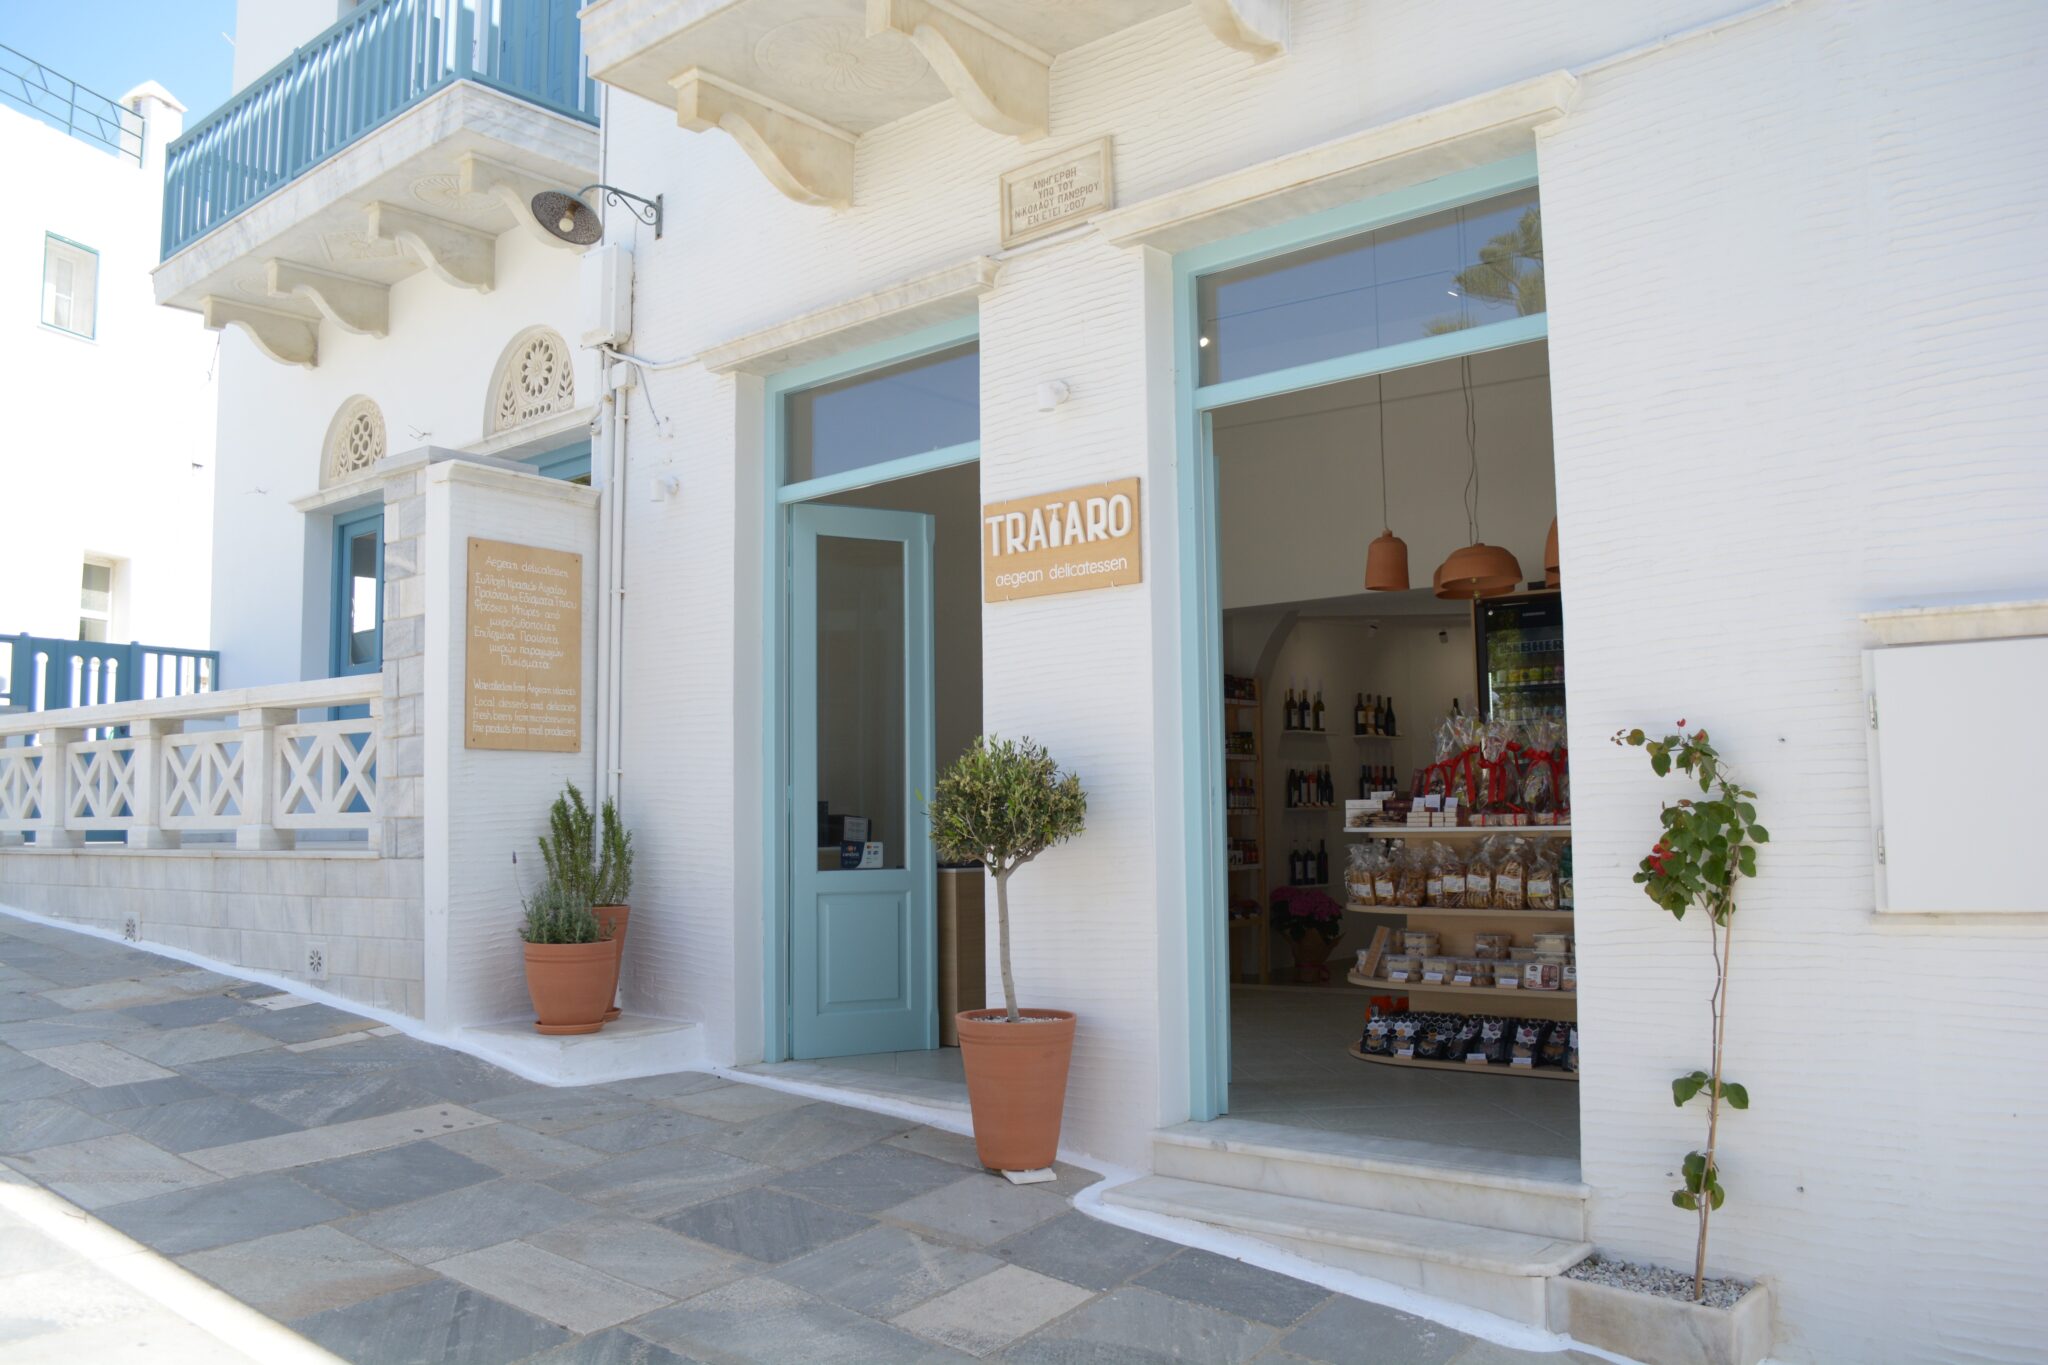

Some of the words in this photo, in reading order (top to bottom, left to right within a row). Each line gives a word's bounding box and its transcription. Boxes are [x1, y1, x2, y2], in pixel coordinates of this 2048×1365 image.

[1033, 167, 1077, 191] ΑΝΗΓΕΡΘΗ
[1039, 187, 1054, 200] ΥΠΟ
[1058, 180, 1074, 194] ΤΟΥ
[1014, 198, 1054, 219] ΝΙΚΟΛΑΟΥ
[1028, 215, 1039, 225] ΕΝ
[1042, 207, 1060, 220] ΕΤΕΙ
[1064, 197, 1087, 213] 2007
[985, 494, 1132, 557] TRATARO
[485, 556, 518, 571] Aegean
[521, 561, 568, 578] delicatessen
[995, 569, 1043, 588] aegean
[1049, 557, 1128, 580] delicatessen
[1497, 639, 1563, 656] LIEBHER
[474, 695, 495, 707] Local
